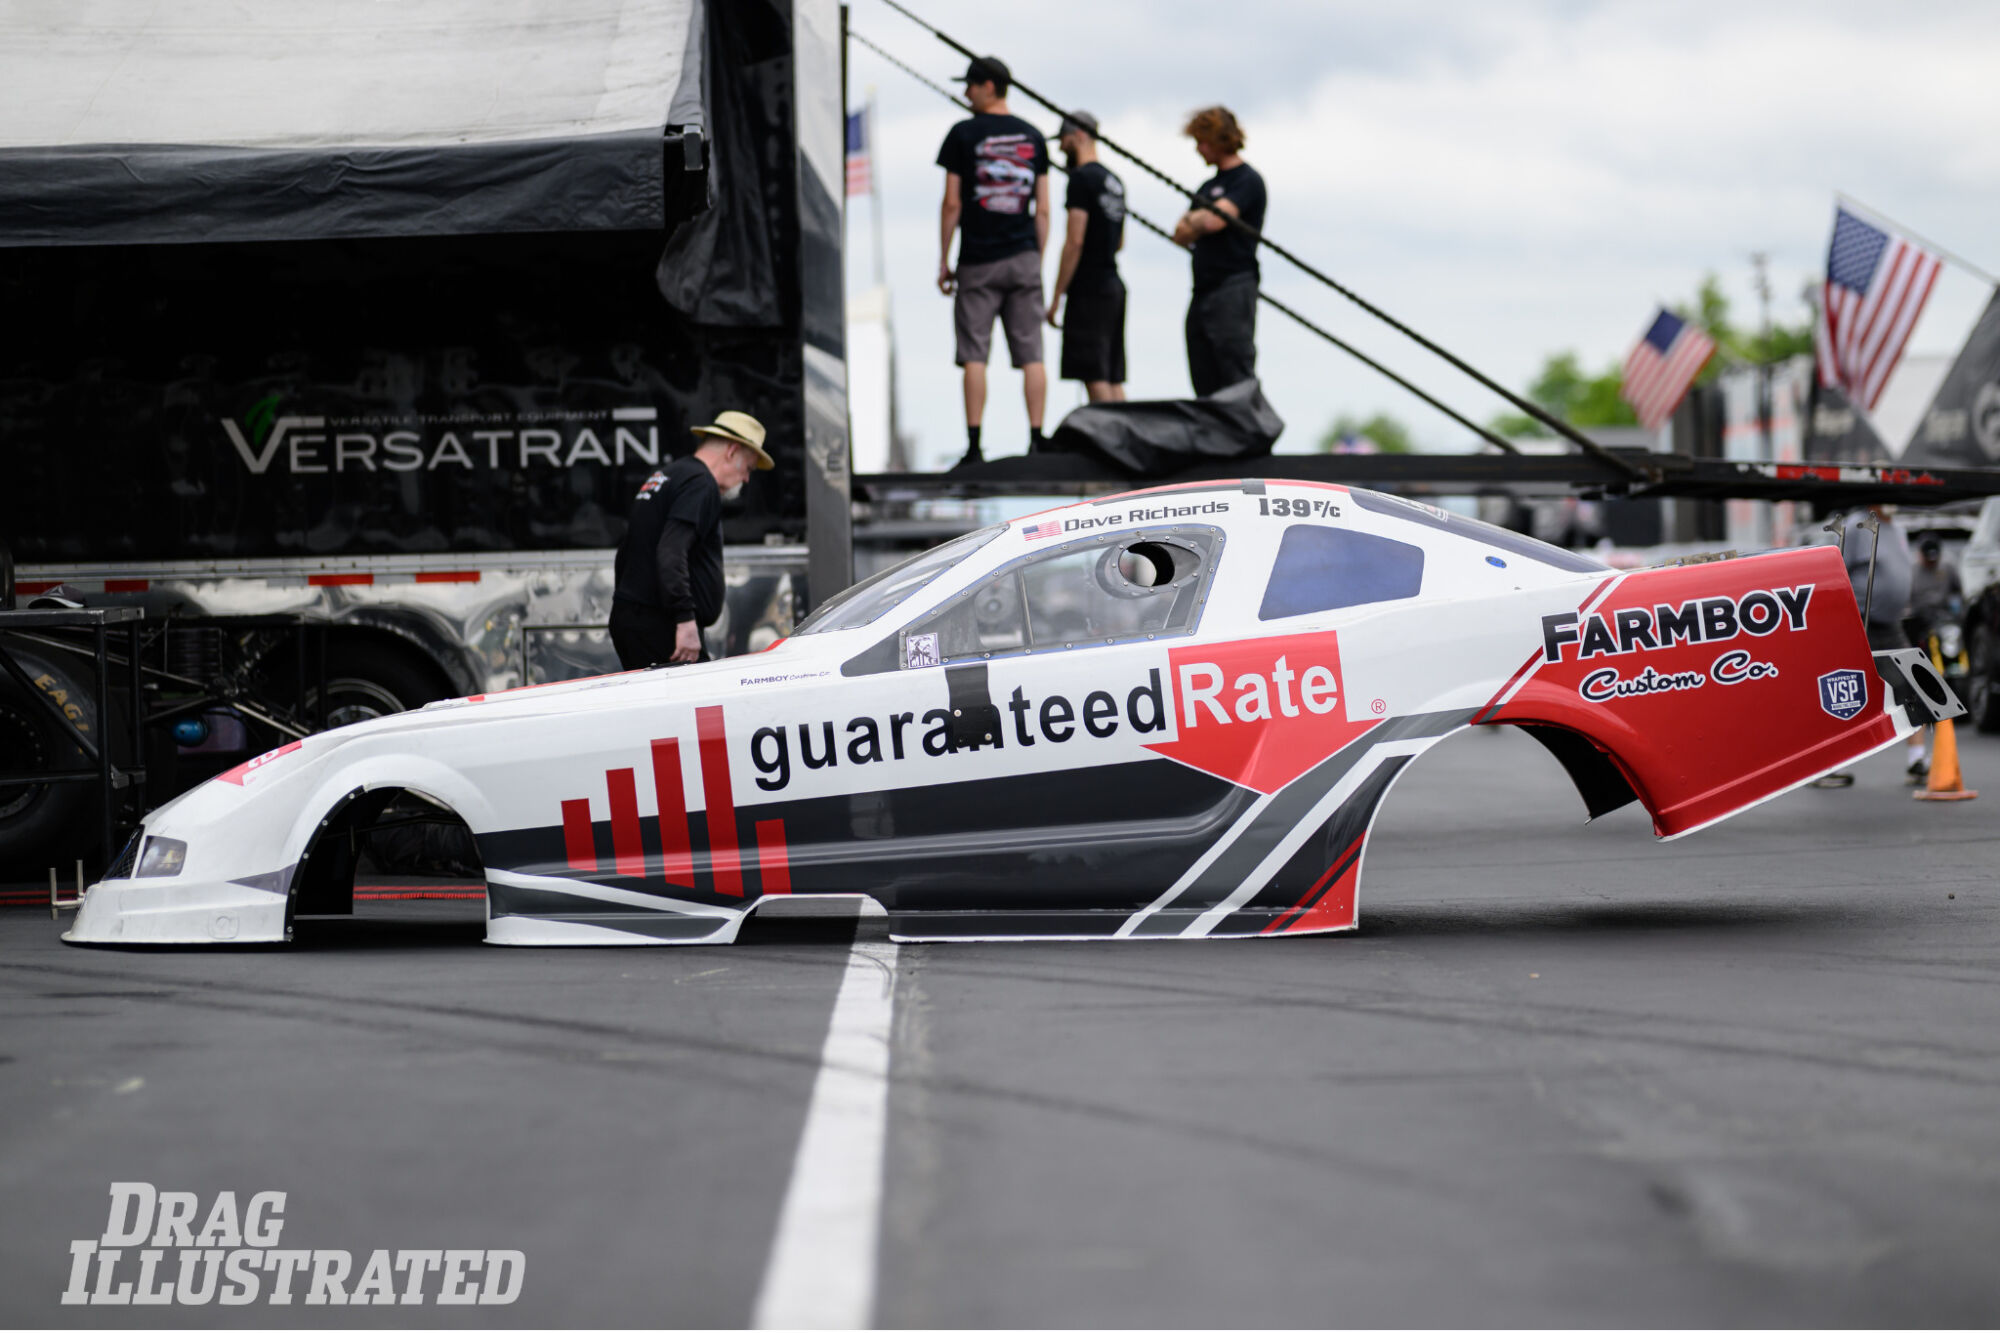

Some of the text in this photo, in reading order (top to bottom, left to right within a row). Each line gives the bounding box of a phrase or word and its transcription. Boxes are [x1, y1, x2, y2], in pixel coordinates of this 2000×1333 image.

[221, 416, 659, 473] VERSATRAN
[1064, 501, 1230, 532] Dave Richards
[1259, 498, 1311, 518] 139
[1541, 584, 1815, 664] FARMBOY
[740, 675, 789, 686] FARMBOY
[1180, 655, 1339, 729] Rate
[1579, 650, 1778, 702] Custom Co.
[1827, 679, 1858, 704] VSP
